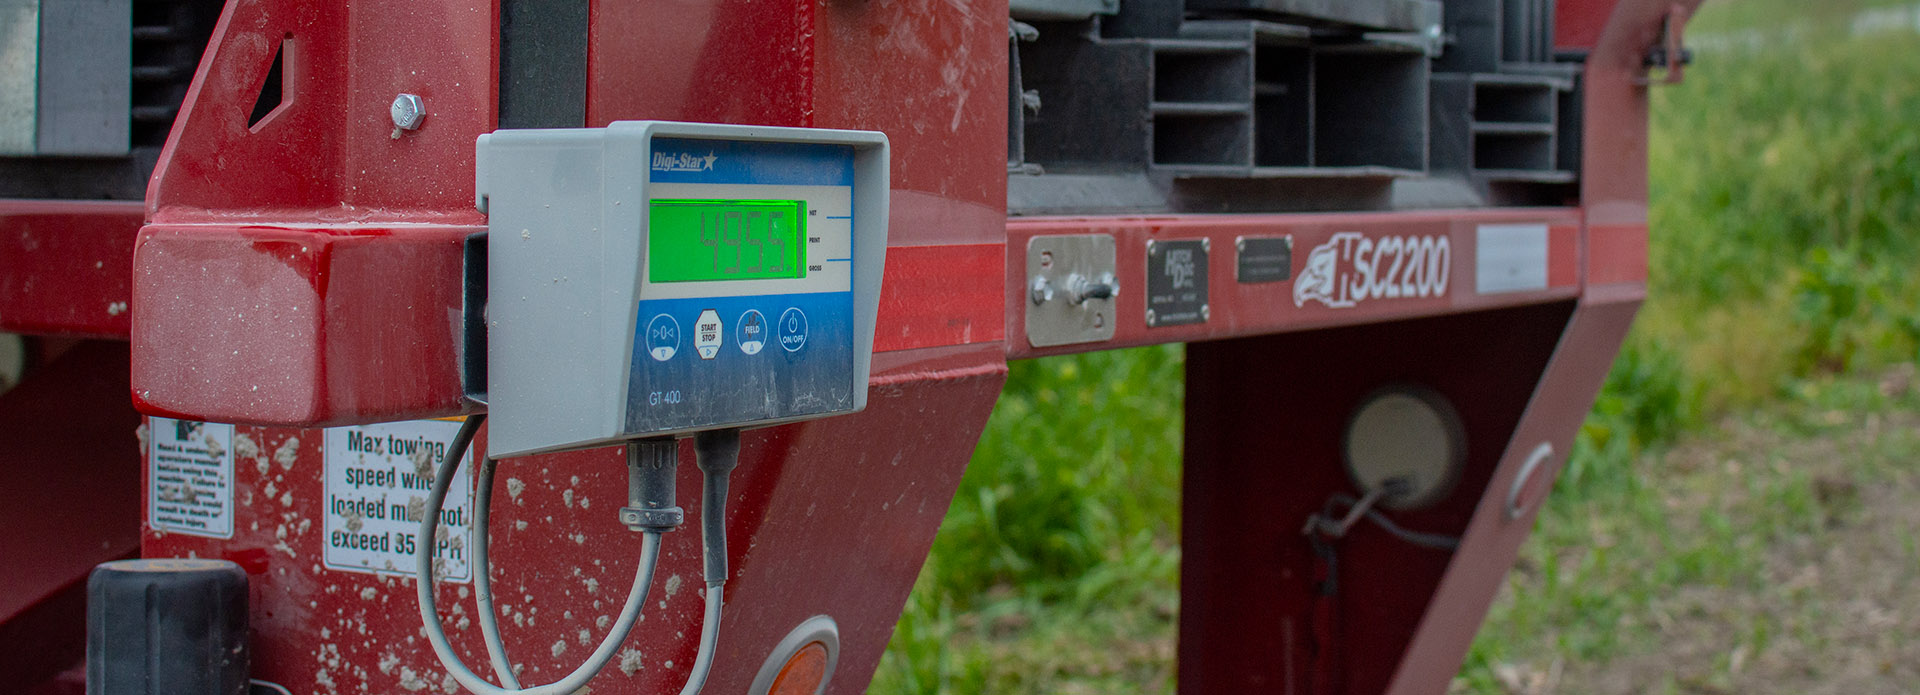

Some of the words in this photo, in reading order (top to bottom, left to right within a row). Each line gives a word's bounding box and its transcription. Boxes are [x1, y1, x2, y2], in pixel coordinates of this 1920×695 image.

[652, 152, 703, 171] Digi-Star
[700, 211, 784, 273] 4955
[701, 323, 717, 332] START
[745, 325, 760, 334] FIELD
[702, 334, 716, 342] STOP
[783, 335, 804, 344] ON/OFF
[650, 391, 662, 406] GT
[664, 390, 681, 404] 400
[348, 430, 383, 454] Max
[346, 466, 396, 489] speed
[331, 493, 386, 519] loaded
[331, 530, 389, 553] exceed
[395, 532, 416, 555] 35
[432, 536, 462, 560] PH
